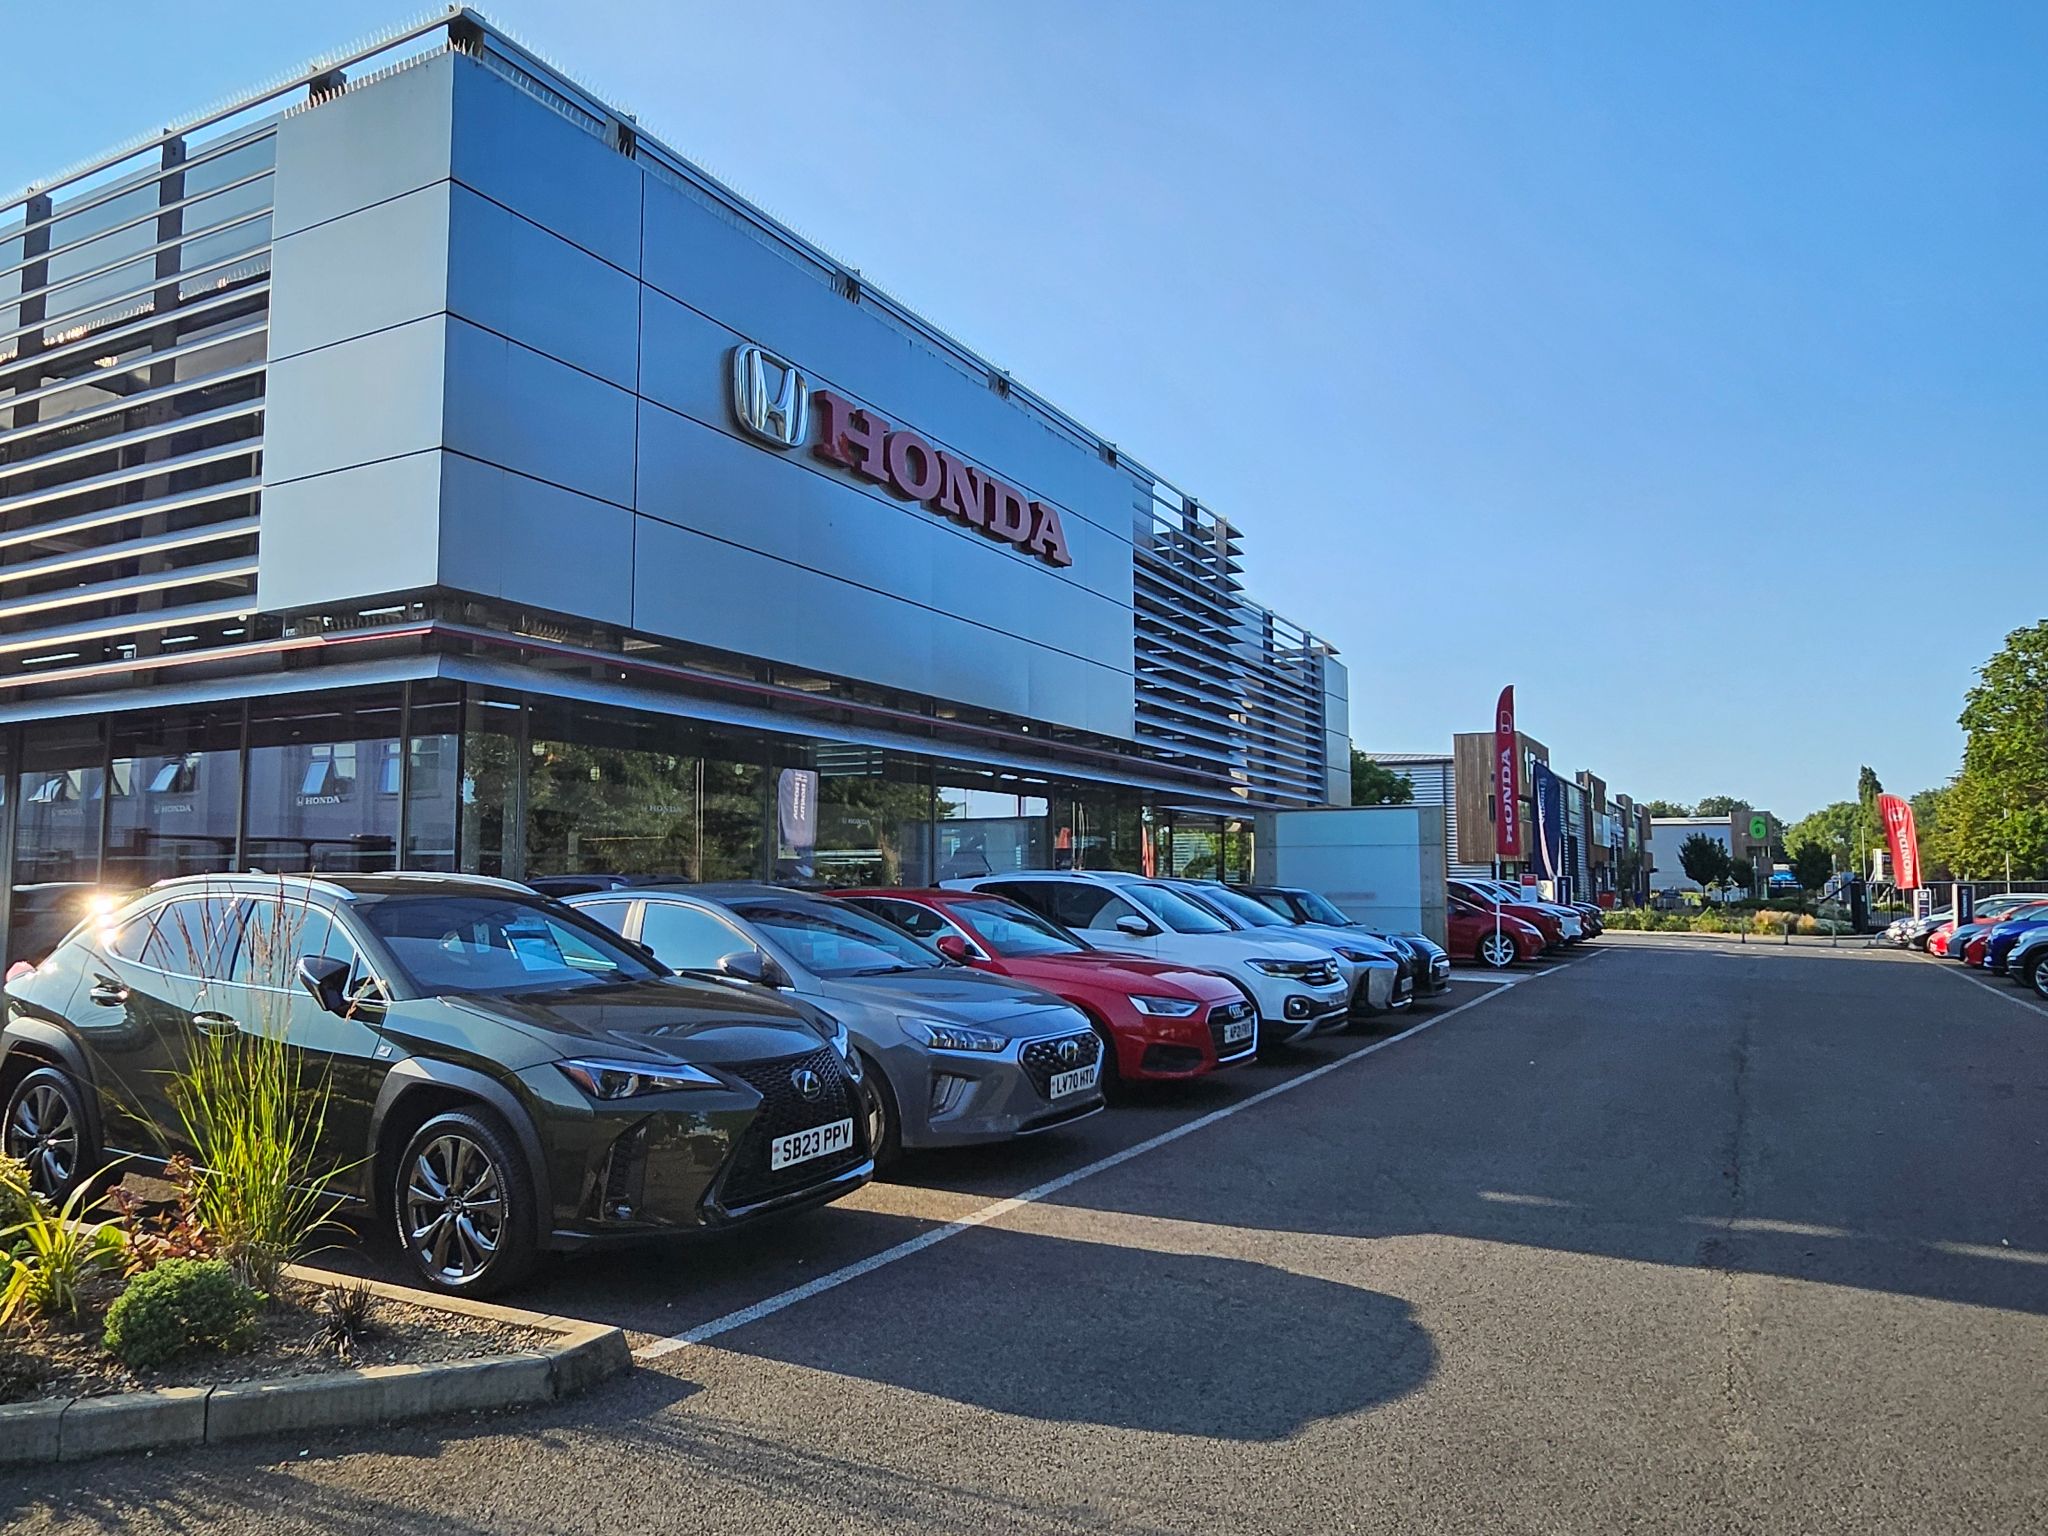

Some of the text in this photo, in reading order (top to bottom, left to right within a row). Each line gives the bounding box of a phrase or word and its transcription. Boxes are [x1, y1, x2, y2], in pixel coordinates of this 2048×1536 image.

[813, 389, 1072, 568] HONDA
[305, 796, 340, 805] HONDA
[1501, 747, 1513, 844] HONDA
[1749, 815, 1766, 839] 6
[1896, 827, 1914, 882] HONDA
[783, 1122, 850, 1162] SB23 PPV
